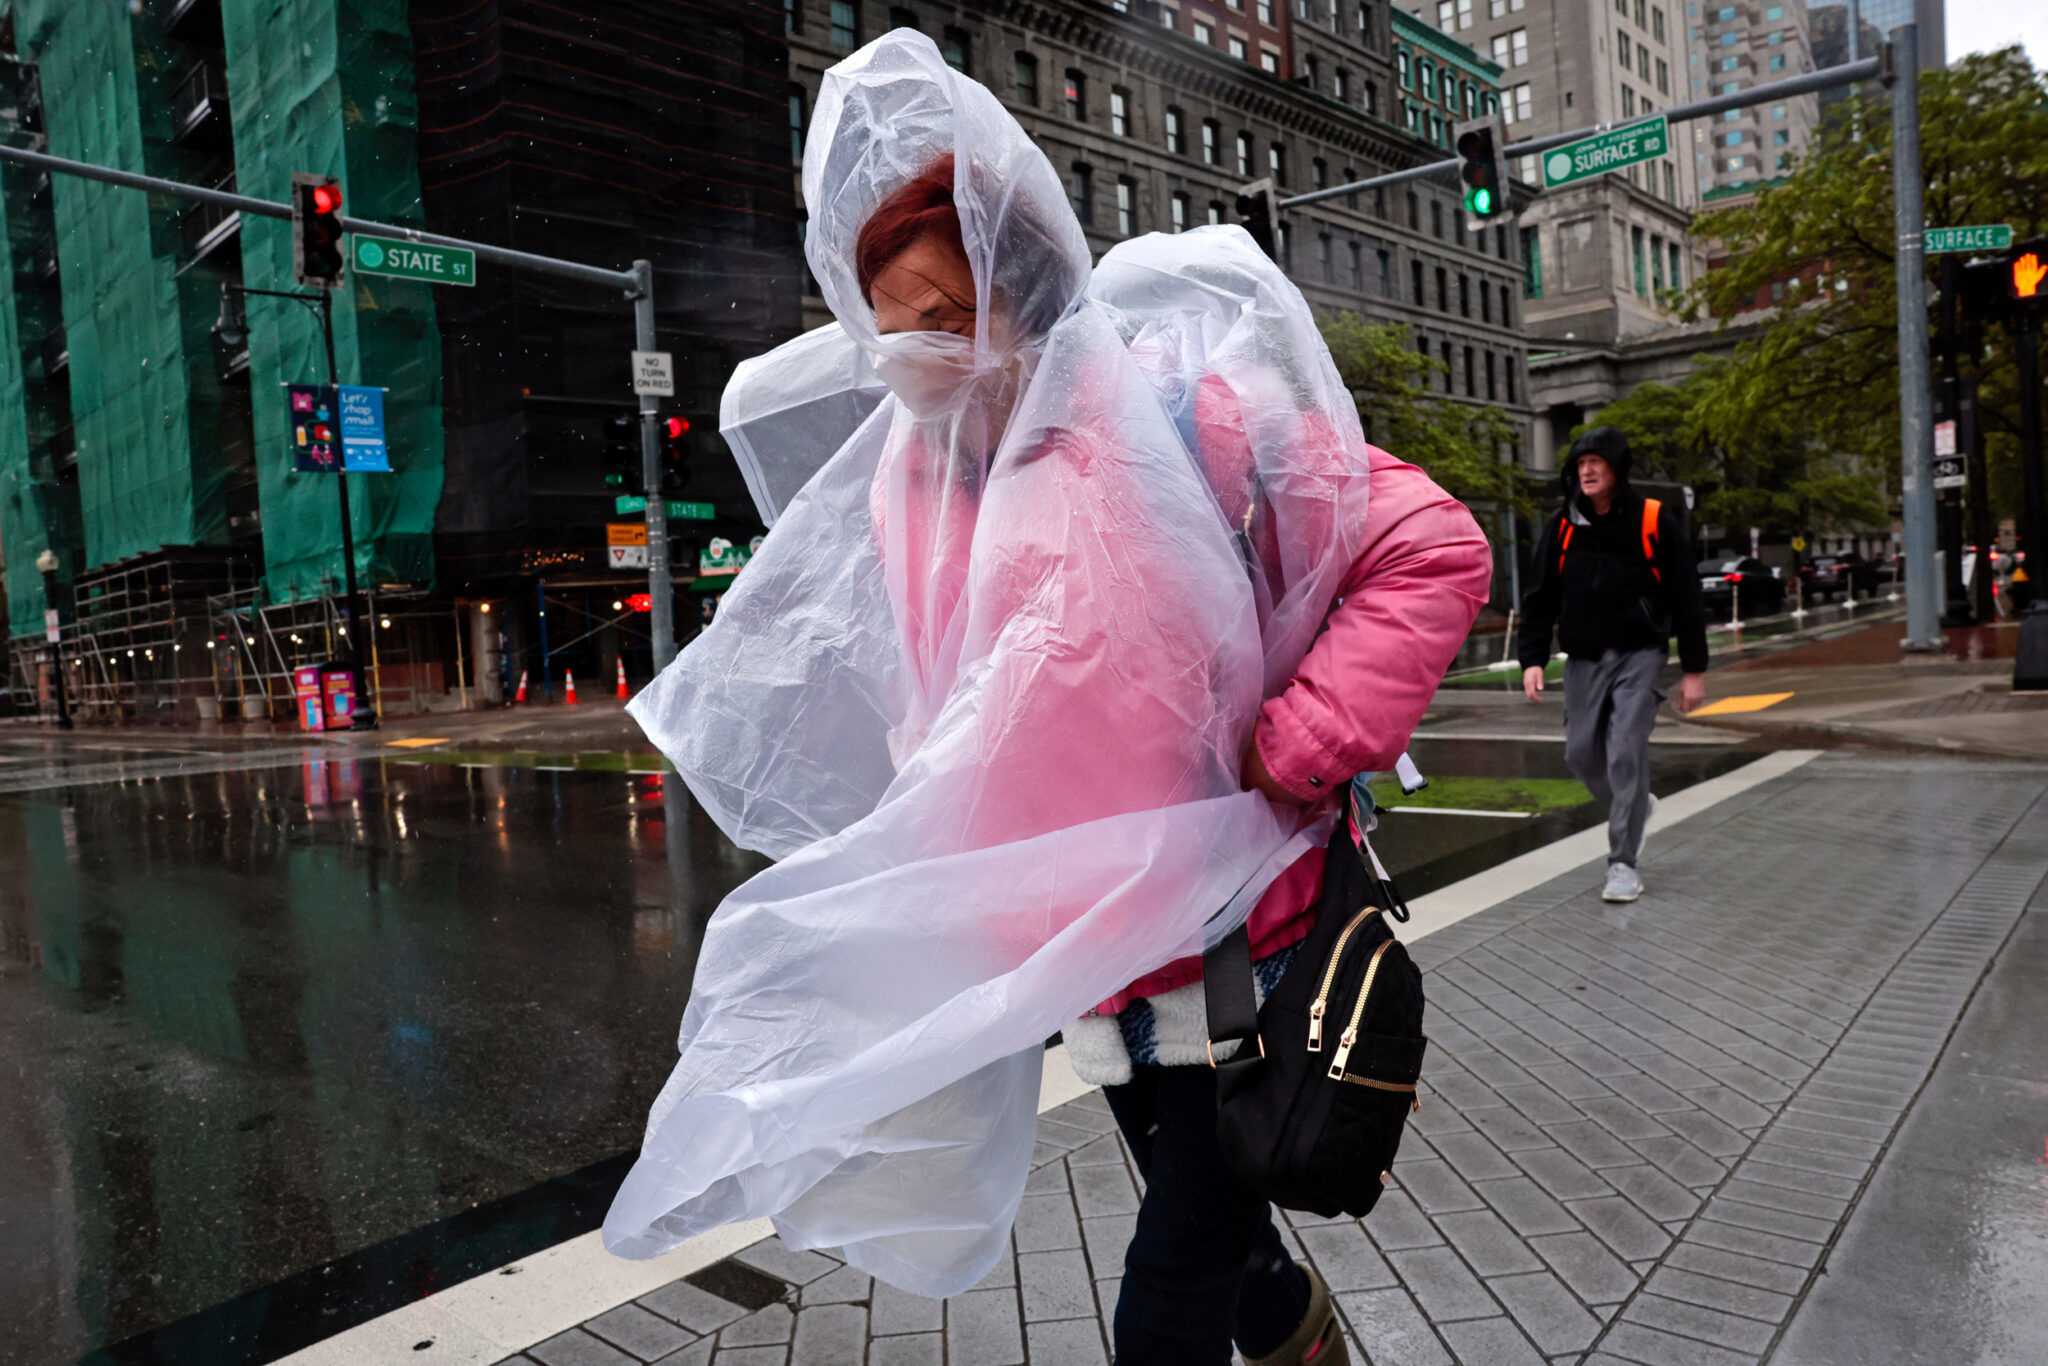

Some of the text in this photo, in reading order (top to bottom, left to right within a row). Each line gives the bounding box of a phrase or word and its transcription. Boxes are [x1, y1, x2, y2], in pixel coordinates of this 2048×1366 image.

[1574, 136, 1660, 173] SURFACE RD
[1925, 228, 1994, 250] SURFACE
[388, 248, 467, 276] STATE ST
[645, 357, 660, 367] NO
[641, 368, 666, 377] TURN
[636, 379, 671, 389] ON RED
[342, 392, 368, 404] Let's
[344, 404, 372, 416] shop
[671, 503, 697, 517] STATE
